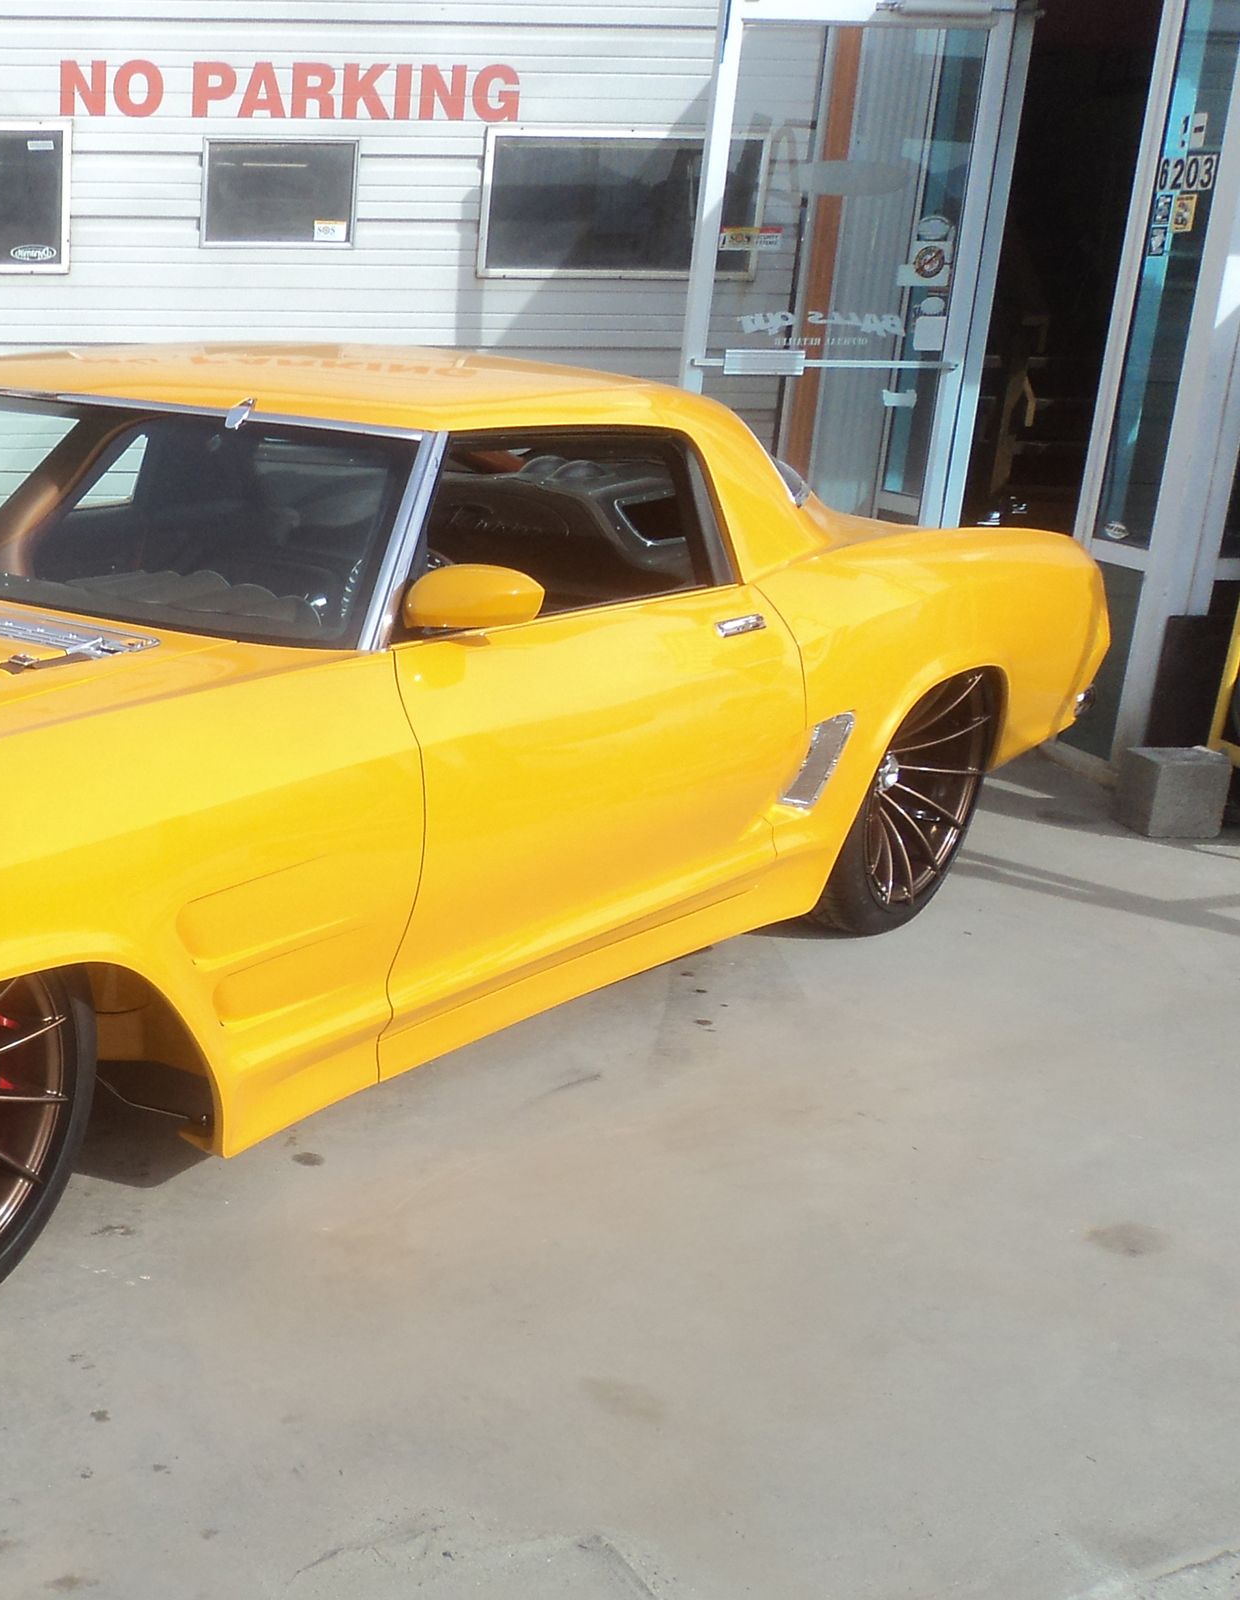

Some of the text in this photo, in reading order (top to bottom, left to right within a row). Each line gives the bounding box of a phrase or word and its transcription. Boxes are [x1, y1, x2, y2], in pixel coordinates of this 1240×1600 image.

[59, 59, 521, 123] NO PARKING
[1157, 156, 1215, 191] 6203
